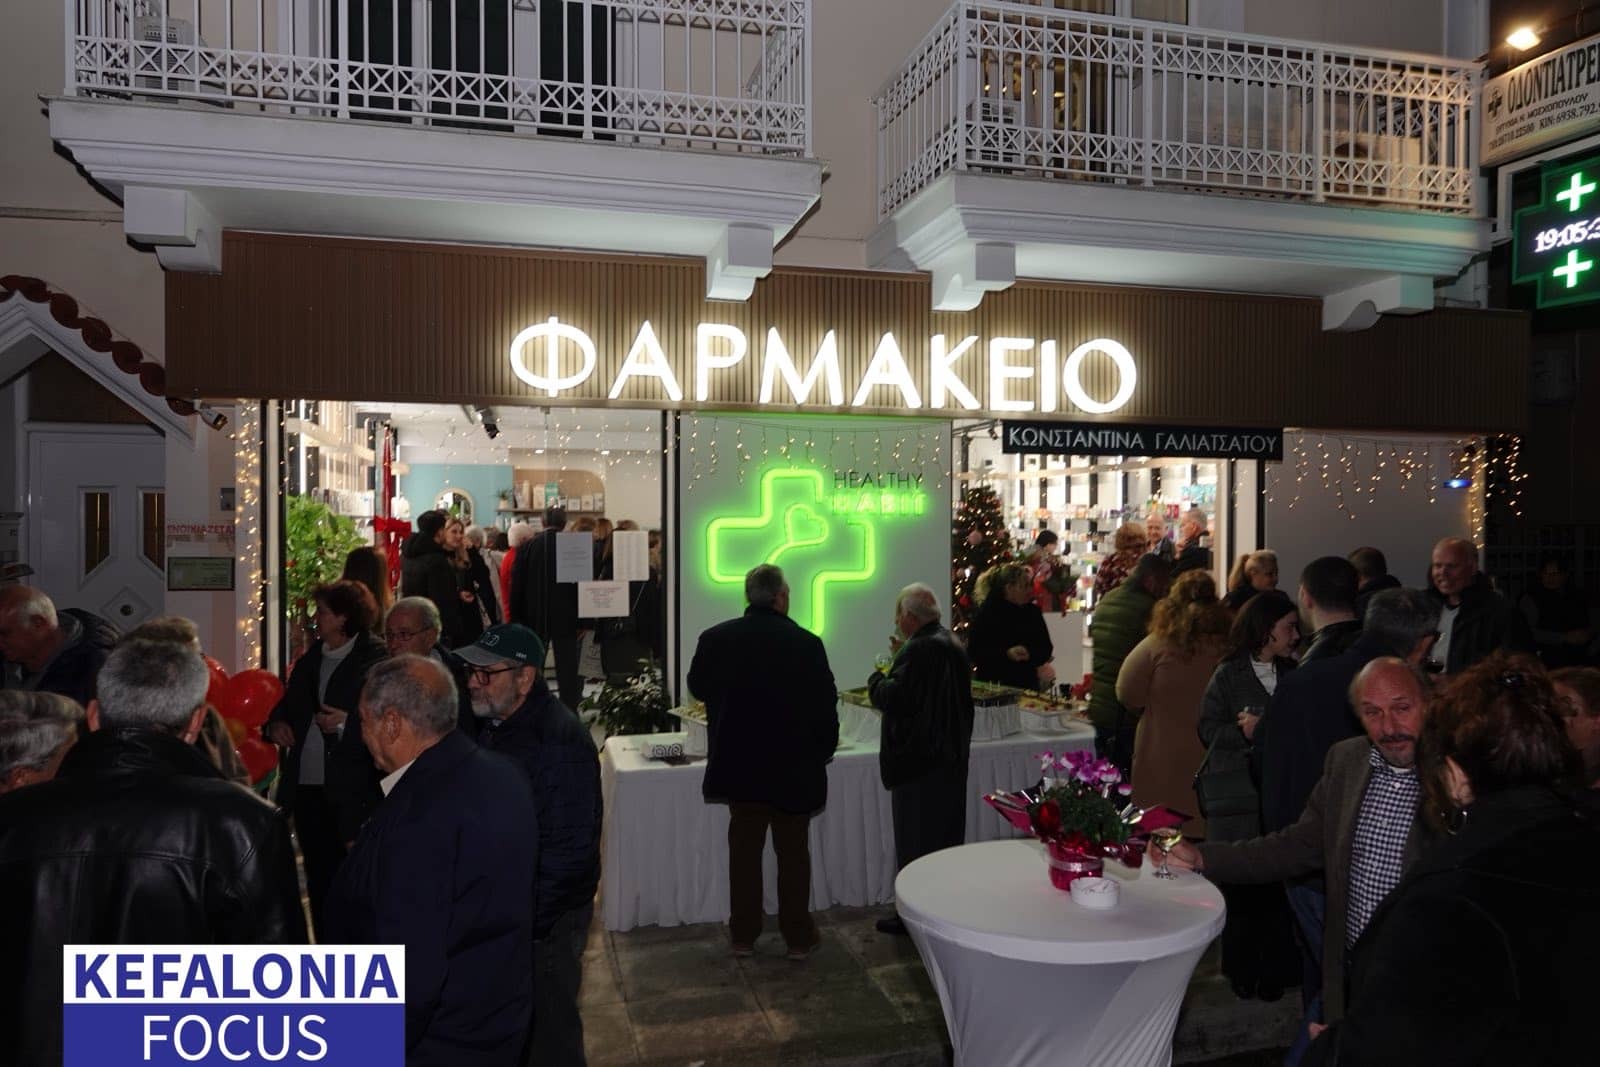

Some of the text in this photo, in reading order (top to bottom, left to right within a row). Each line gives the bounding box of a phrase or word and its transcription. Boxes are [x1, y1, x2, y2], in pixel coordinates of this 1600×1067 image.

[509, 316, 1138, 414] ΦΑΡΜΑΚΕΙΟ
[1008, 427, 1277, 453] ΚΩΝΣΤΑΝΤΙΝΑ ΓΑΛΙΑΤΣΑΤΟΥ
[833, 471, 923, 489] HEALTHY
